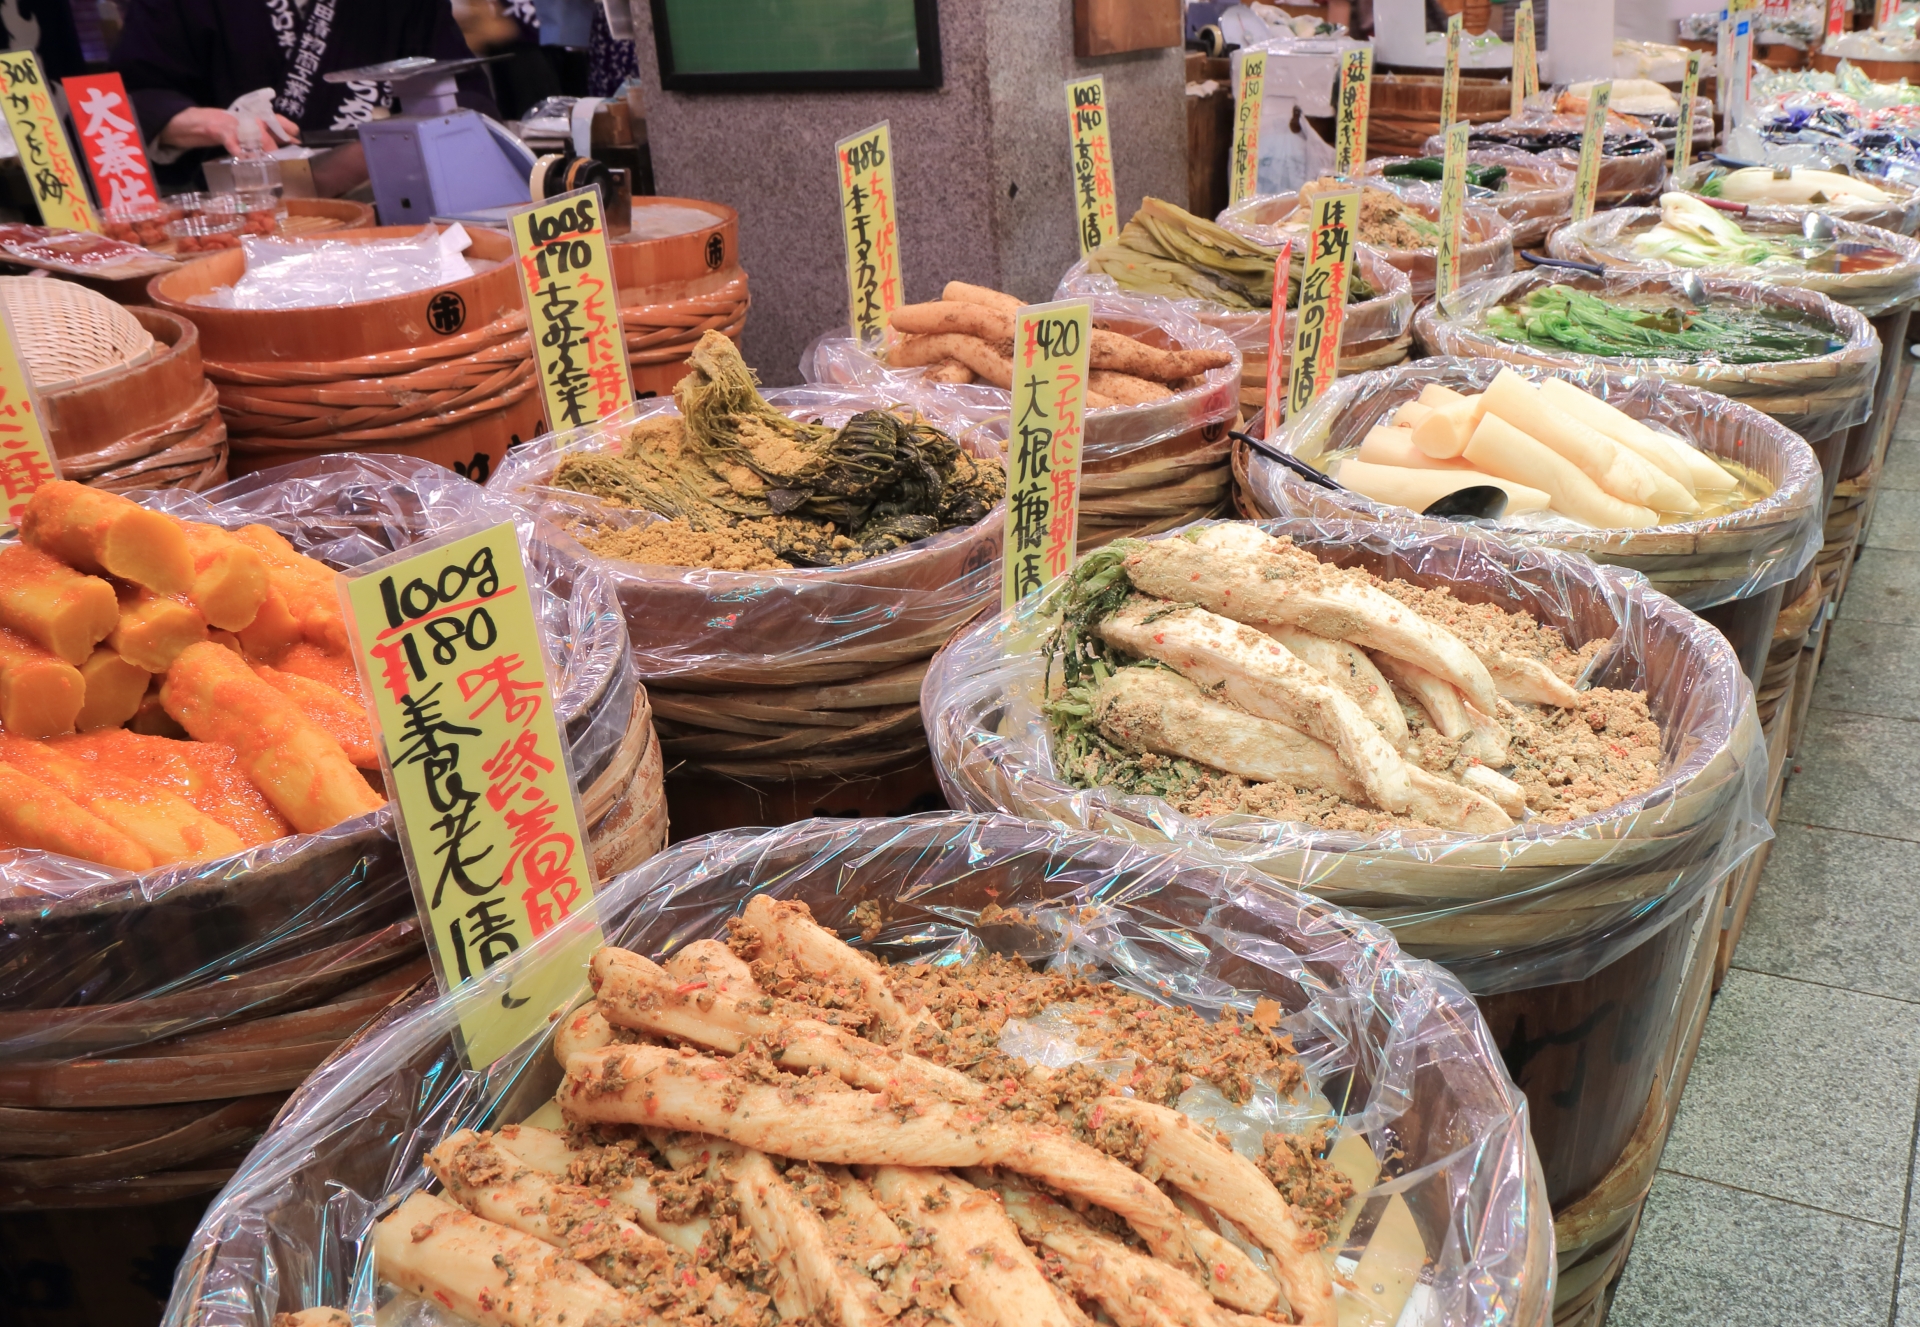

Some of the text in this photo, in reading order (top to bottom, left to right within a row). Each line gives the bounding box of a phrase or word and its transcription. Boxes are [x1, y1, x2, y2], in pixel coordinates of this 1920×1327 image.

[79, 88, 157, 216] 大奉仕
[839, 135, 886, 188] ¥486
[1075, 138, 1102, 253] 高菜漬
[521, 240, 592, 293] ¥170
[430, 294, 463, 332] 市
[1023, 319, 1080, 368] ¥420
[1292, 266, 1331, 414] 紀の川漬
[379, 546, 500, 629] 100g
[370, 606, 499, 705] ¥180
